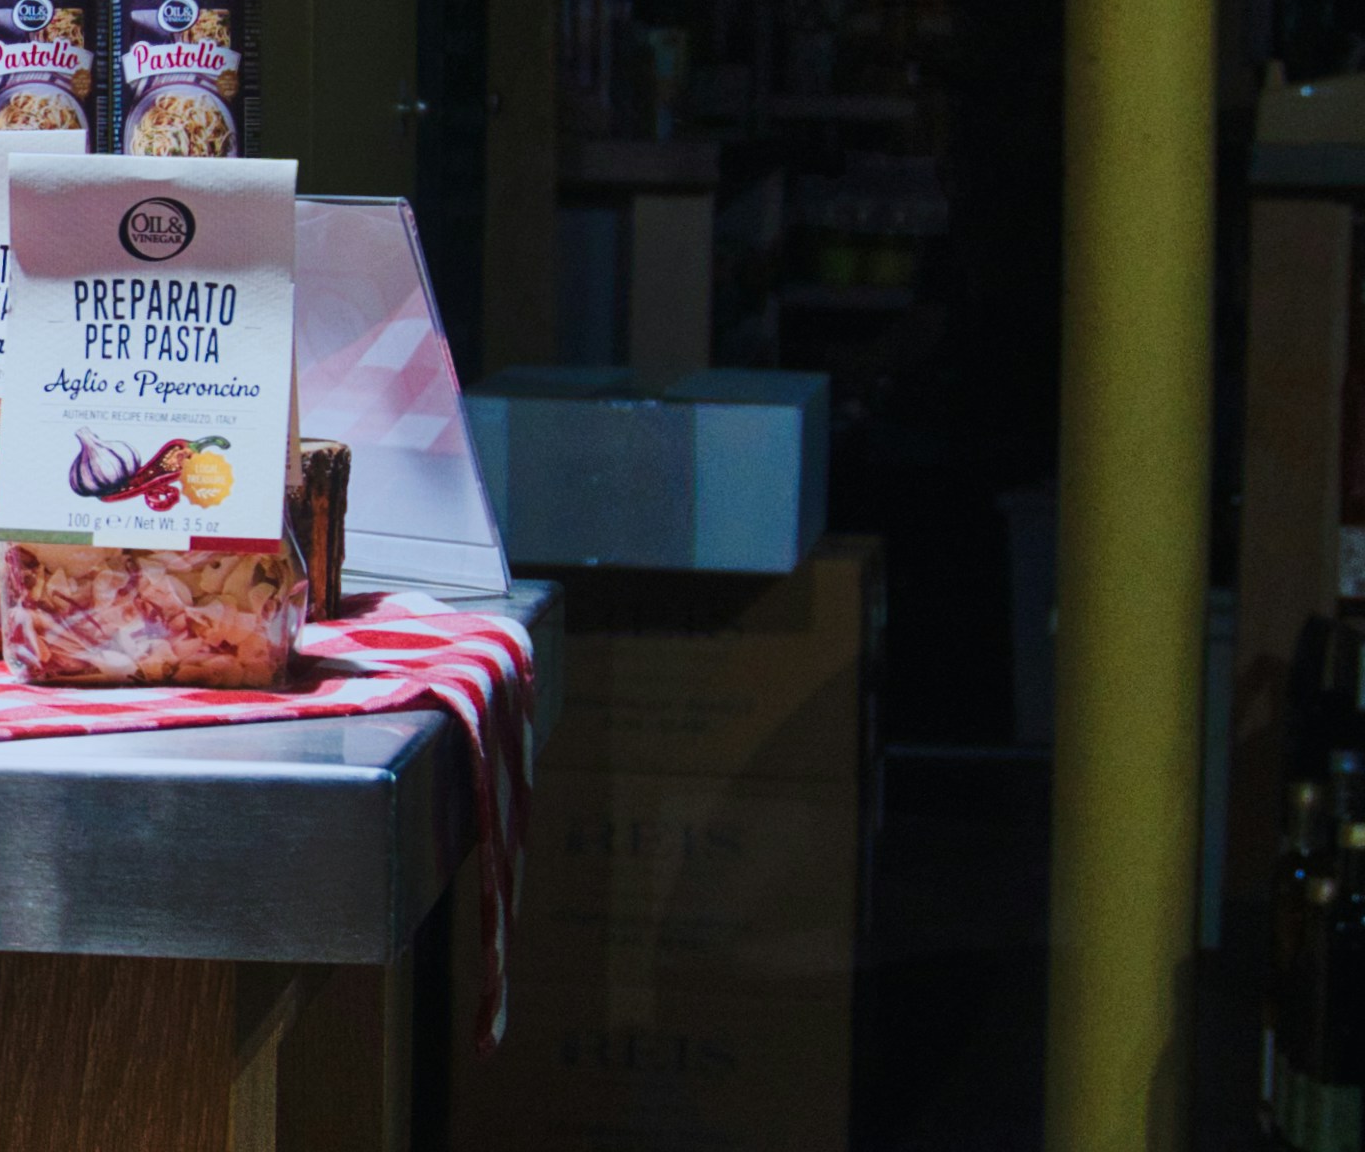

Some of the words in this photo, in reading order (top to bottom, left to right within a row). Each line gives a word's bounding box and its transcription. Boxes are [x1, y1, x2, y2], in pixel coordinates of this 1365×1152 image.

[133, 42, 227, 73] Pastolio
[131, 213, 187, 235] OIL&
[131, 234, 183, 244] VINEGAR
[74, 279, 237, 326] PREPARATO
[85, 324, 131, 360] PER
[144, 324, 219, 364] PASTA
[43, 368, 107, 400] Aglio
[115, 378, 125, 393] e
[133, 370, 260, 403] Peperoncino
[63, 410, 109, 421] AUTHENTIC
[112, 410, 141, 422] RECIPE
[145, 412, 167, 422] FROM
[215, 415, 237, 424] ITALY
[67, 512, 90, 528] 100
[94, 516, 101, 530] g
[135, 516, 155, 530] Net
[159, 518, 176, 531] Wt.
[183, 518, 203, 532] 3.5
[206, 522, 219, 532] oz
